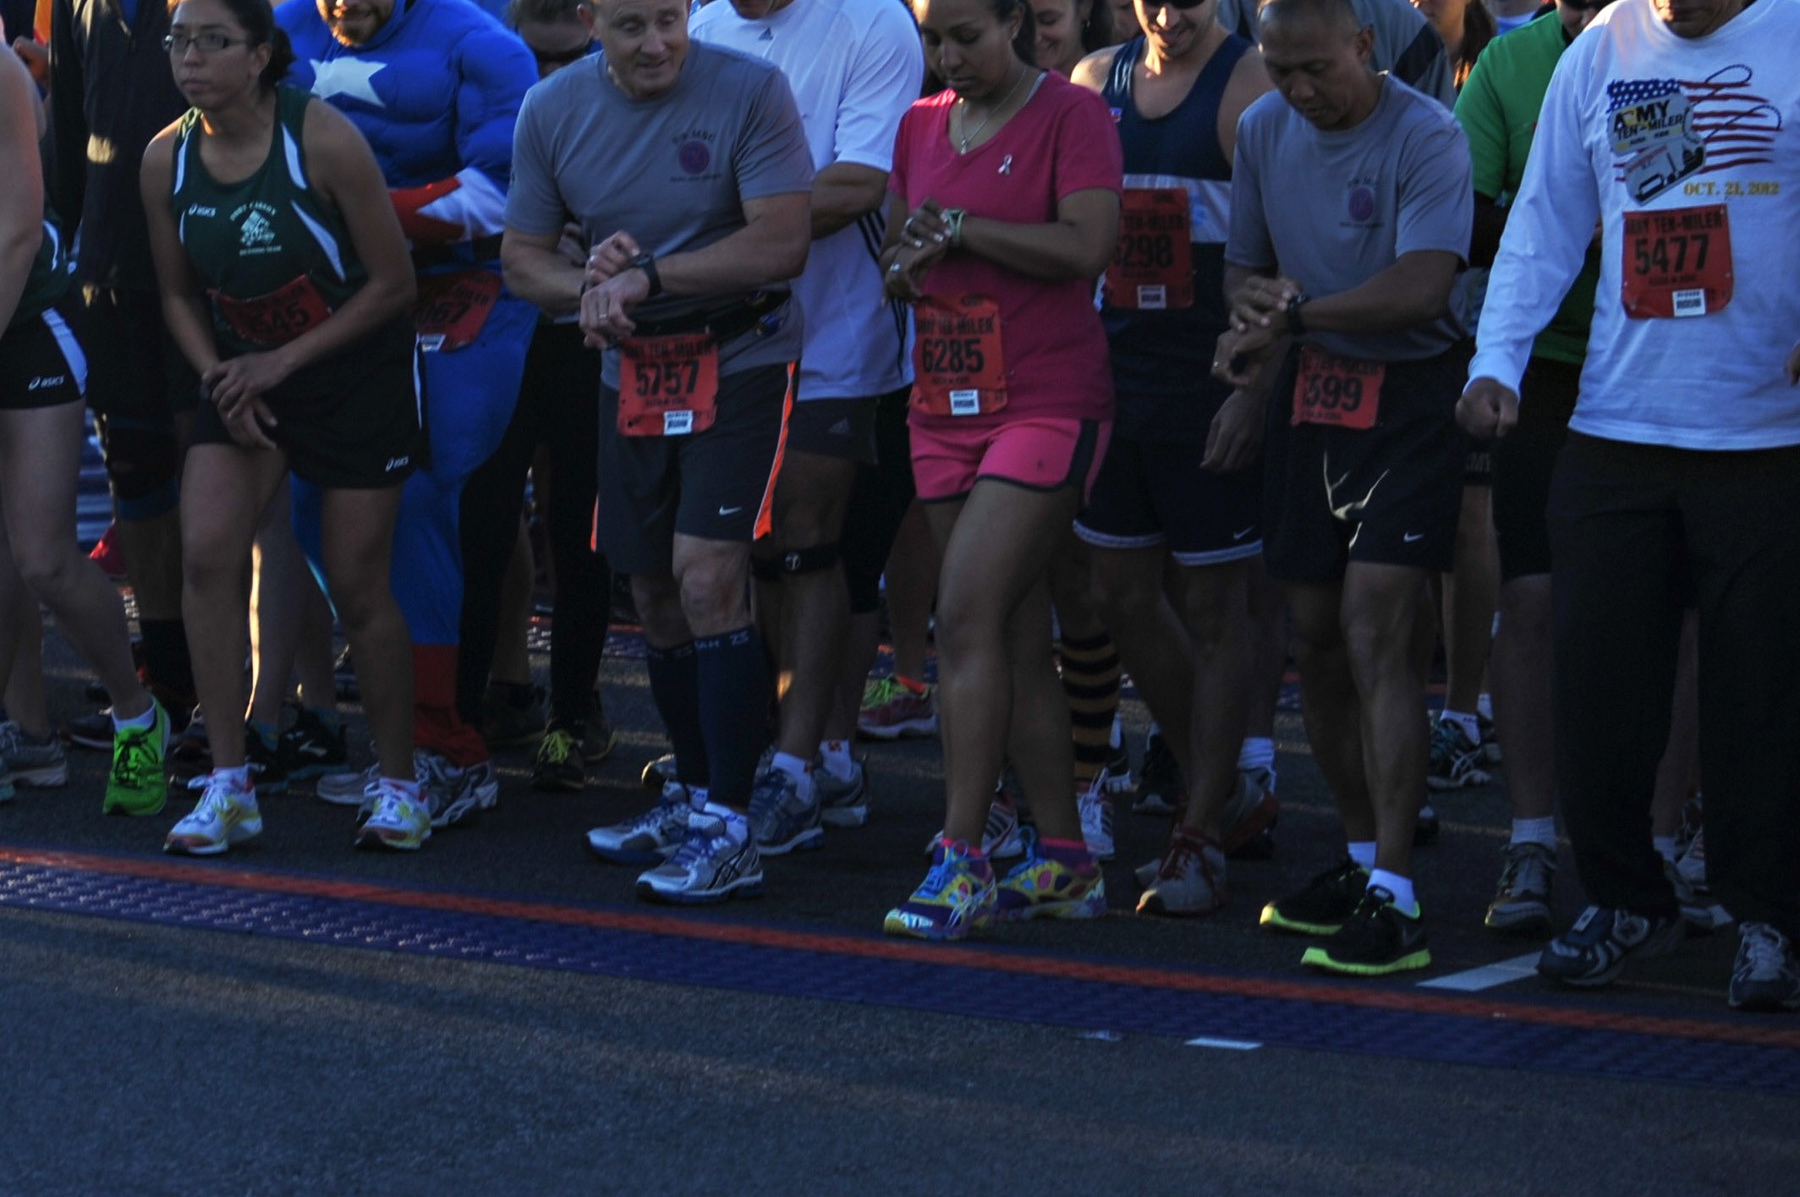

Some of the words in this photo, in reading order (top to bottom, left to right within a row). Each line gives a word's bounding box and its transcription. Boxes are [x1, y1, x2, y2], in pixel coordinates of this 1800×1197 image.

[1613, 99, 1670, 133] ARMY
[1684, 182, 1720, 196] OCT.
[1747, 181, 1780, 195] 2012
[1634, 233, 1709, 276] 5477
[921, 337, 985, 373] 6285
[635, 359, 700, 397] 5757
